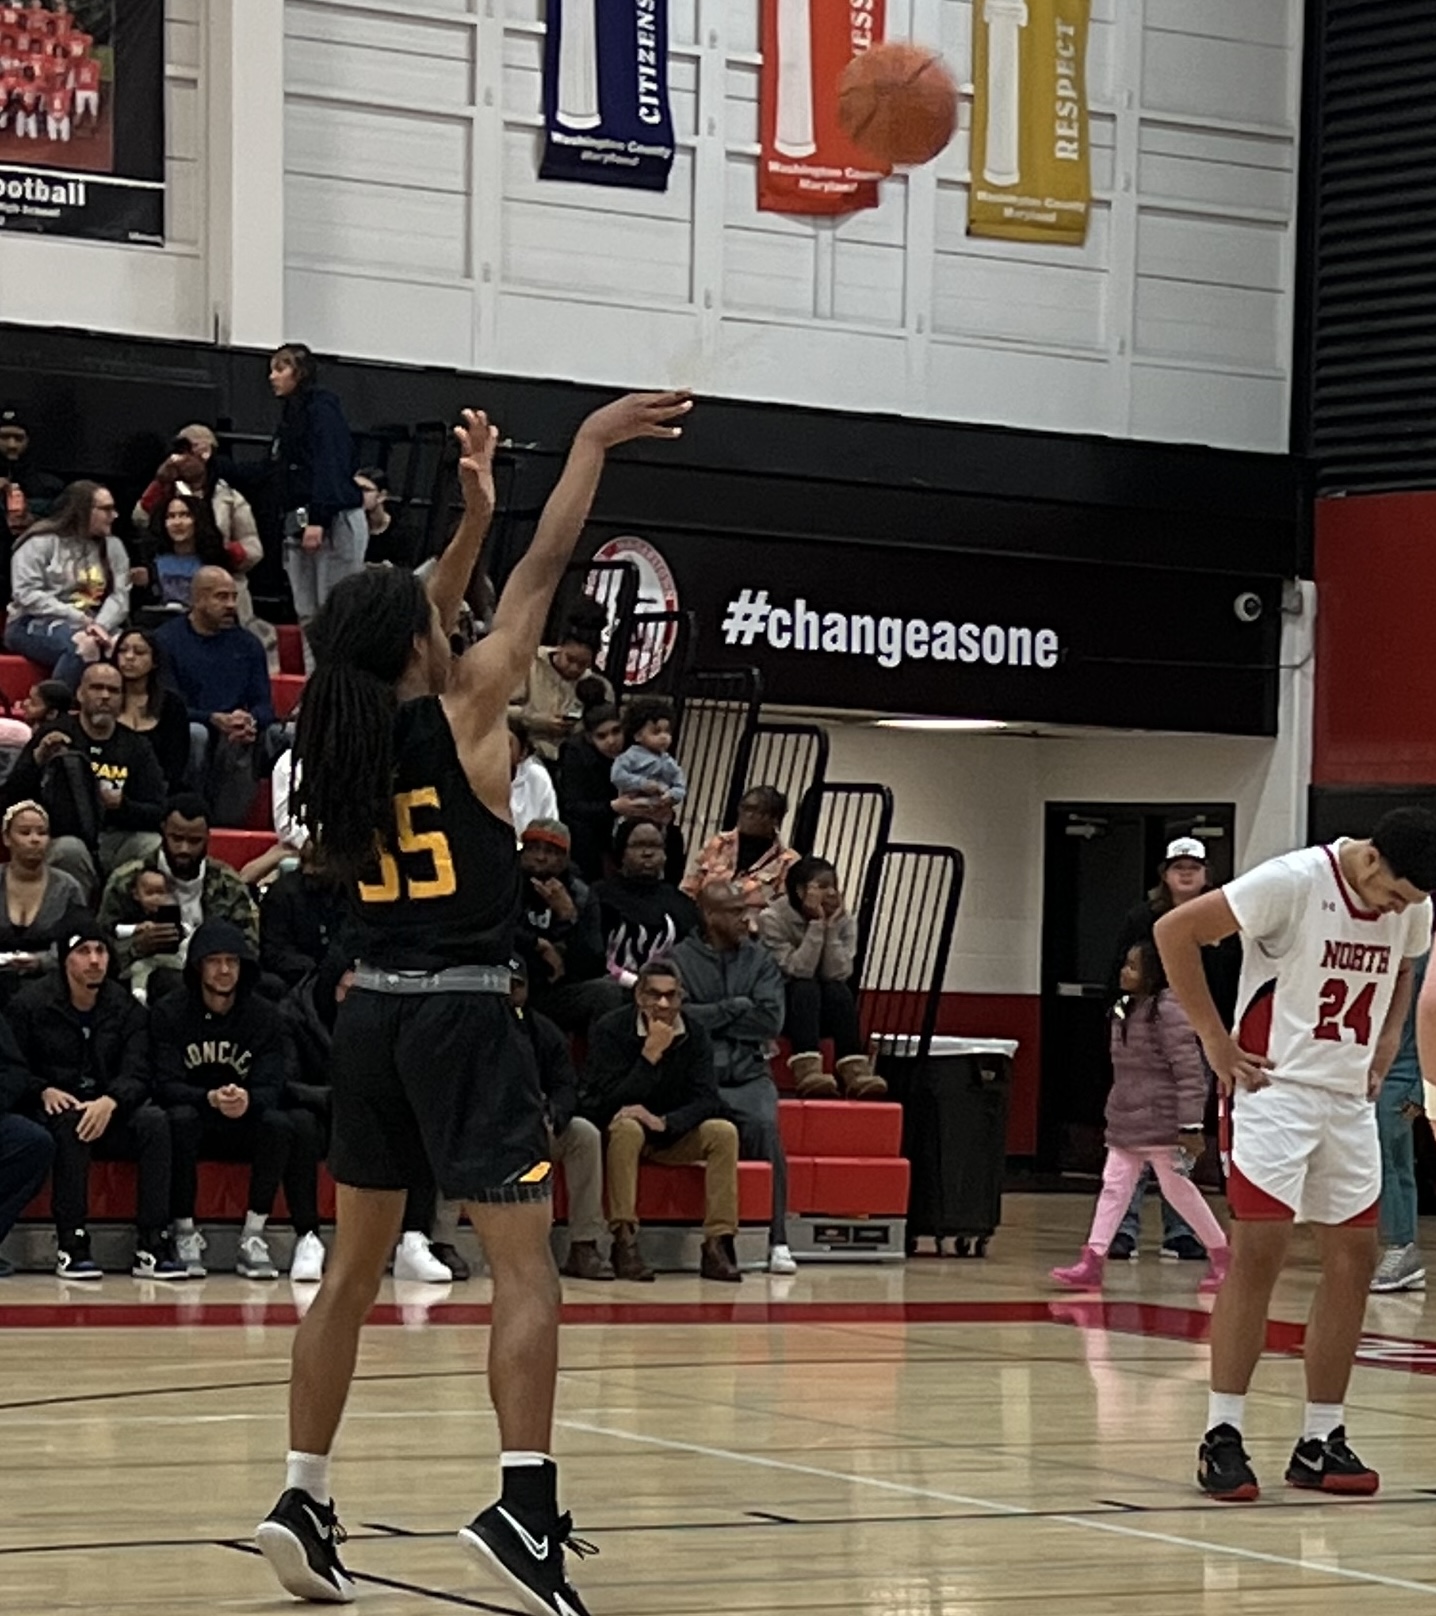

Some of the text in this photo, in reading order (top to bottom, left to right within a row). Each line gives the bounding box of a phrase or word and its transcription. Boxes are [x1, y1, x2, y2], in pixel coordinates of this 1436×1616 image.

[1055, 18, 1079, 160] RESPECT
[721, 588, 1059, 668] #changeasone
[1320, 940, 1391, 974] NORTH
[1312, 978, 1378, 1046] 24
